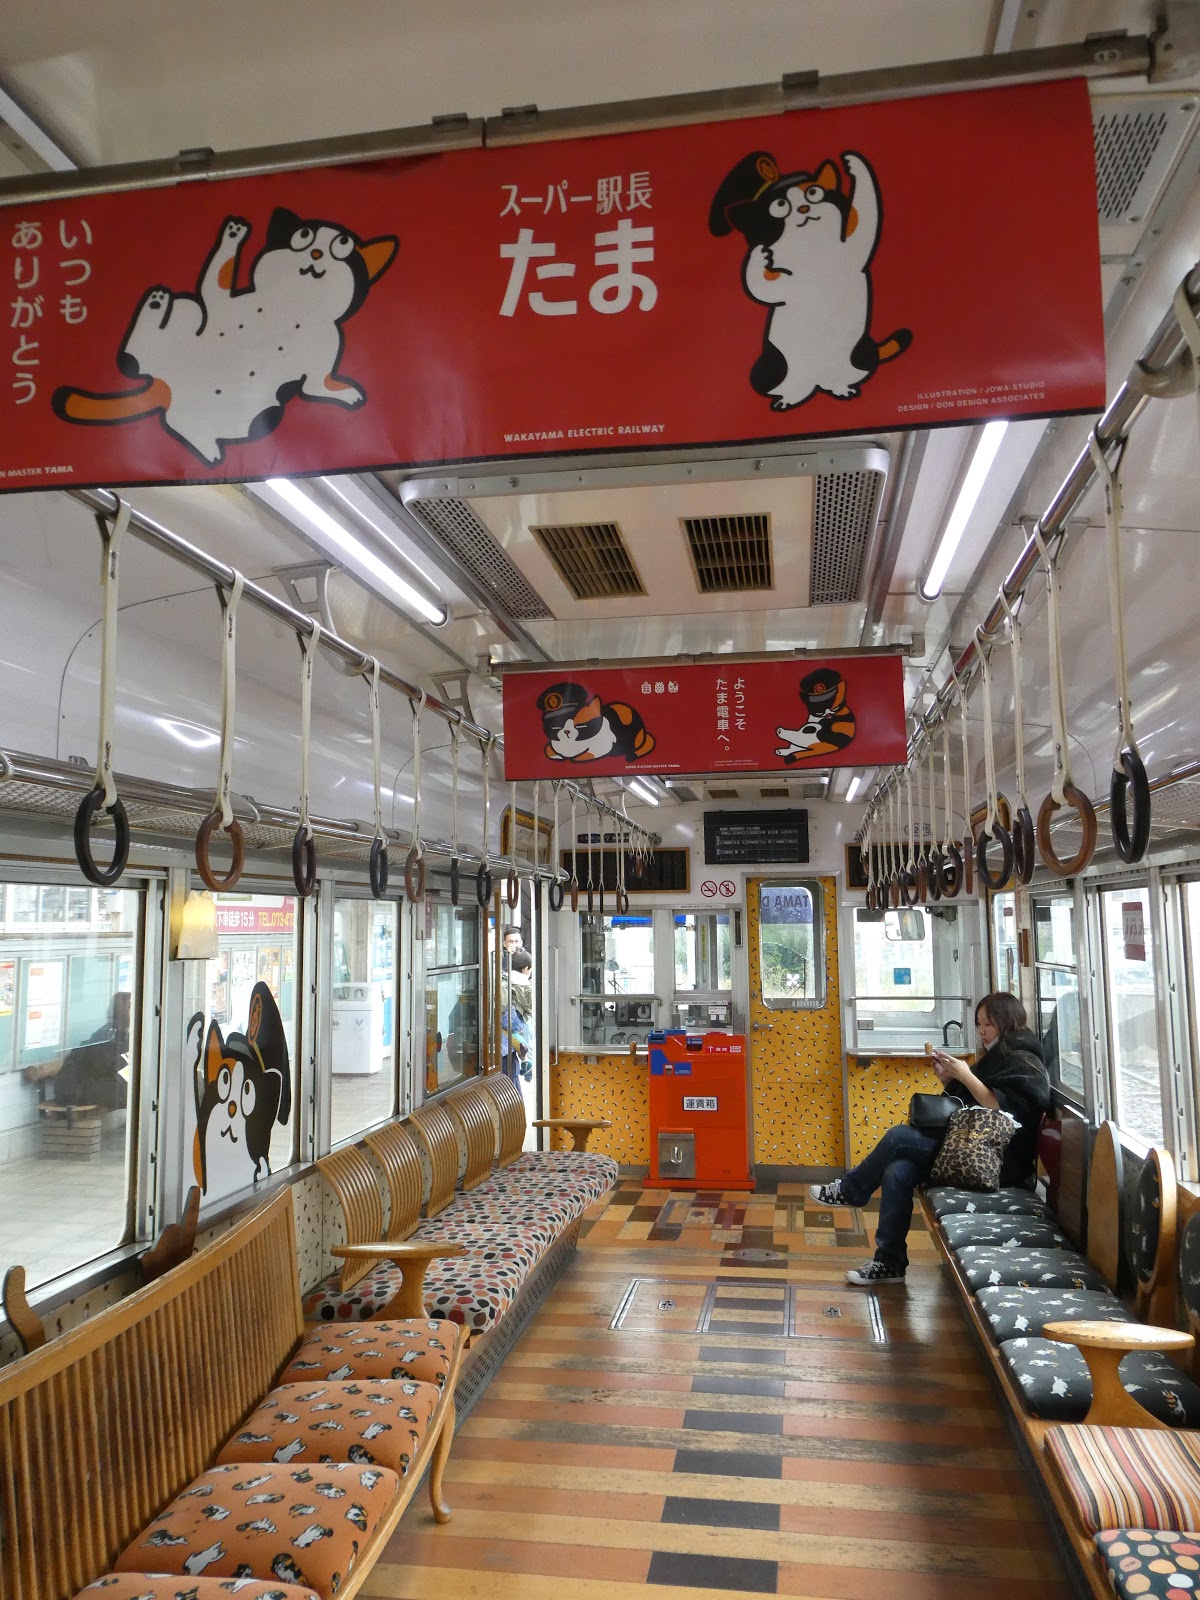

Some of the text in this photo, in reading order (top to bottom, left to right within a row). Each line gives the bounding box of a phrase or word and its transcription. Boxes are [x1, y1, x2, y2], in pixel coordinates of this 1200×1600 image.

[500, 171, 653, 217] スーパー駅長
[59, 219, 93, 324] いつも
[499, 218, 658, 317] たま
[11, 220, 44, 405] ありがとう
[897, 403, 929, 412] DESIGN
[957, 398, 988, 407] DESIGN
[990, 392, 1045, 404] ASSOCIATES
[917, 387, 977, 400] ILLUSTRATION
[504, 424, 665, 443] WAKAYAMA ELECTRIC RAILWAY
[8, 467, 42, 477] MASTER
[44, 465, 74, 474] TAMA
[716, 678, 730, 751] たま電車へ。
[733, 678, 746, 731] ようこそ
[685, 1098, 716, 1109] 運賃箱
